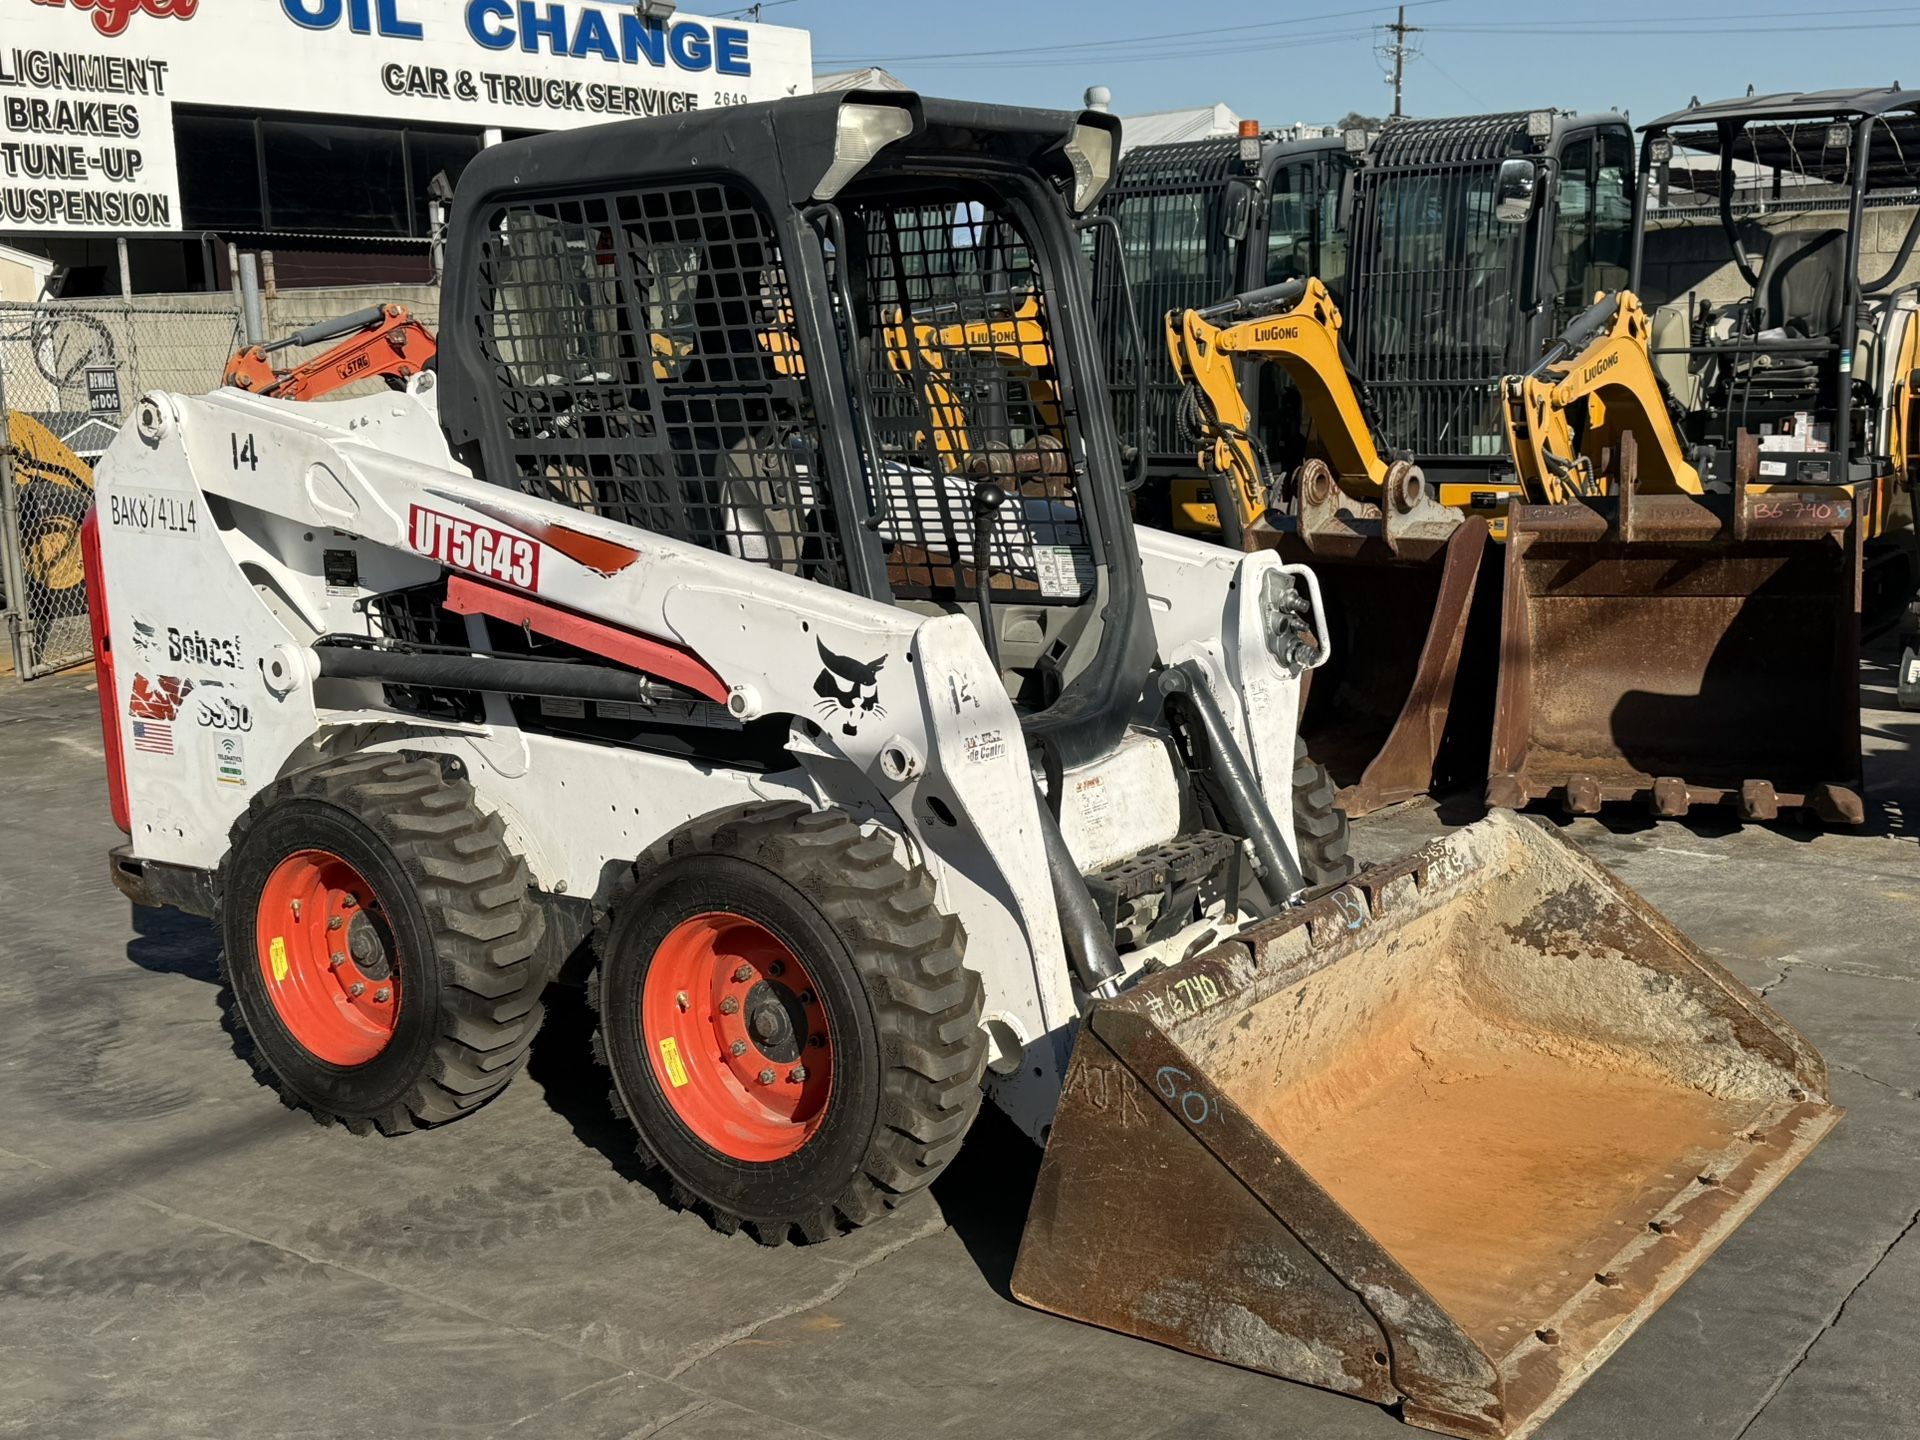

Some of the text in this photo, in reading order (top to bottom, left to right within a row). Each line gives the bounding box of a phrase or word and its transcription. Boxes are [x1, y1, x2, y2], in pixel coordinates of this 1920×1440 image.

[465, 0, 751, 77] CHANGE
[381, 62, 698, 117] CAR & TRUCK SERVICE
[714, 91, 748, 106] 2649
[5, 95, 141, 138] BRAKES
[1, 141, 144, 181] TUNE-UP
[0, 187, 171, 228] USPENSION
[100, 393, 119, 409] DOG
[231, 432, 259, 472] 14
[110, 494, 197, 534] BAK874114
[414, 508, 534, 588] UT5G43
